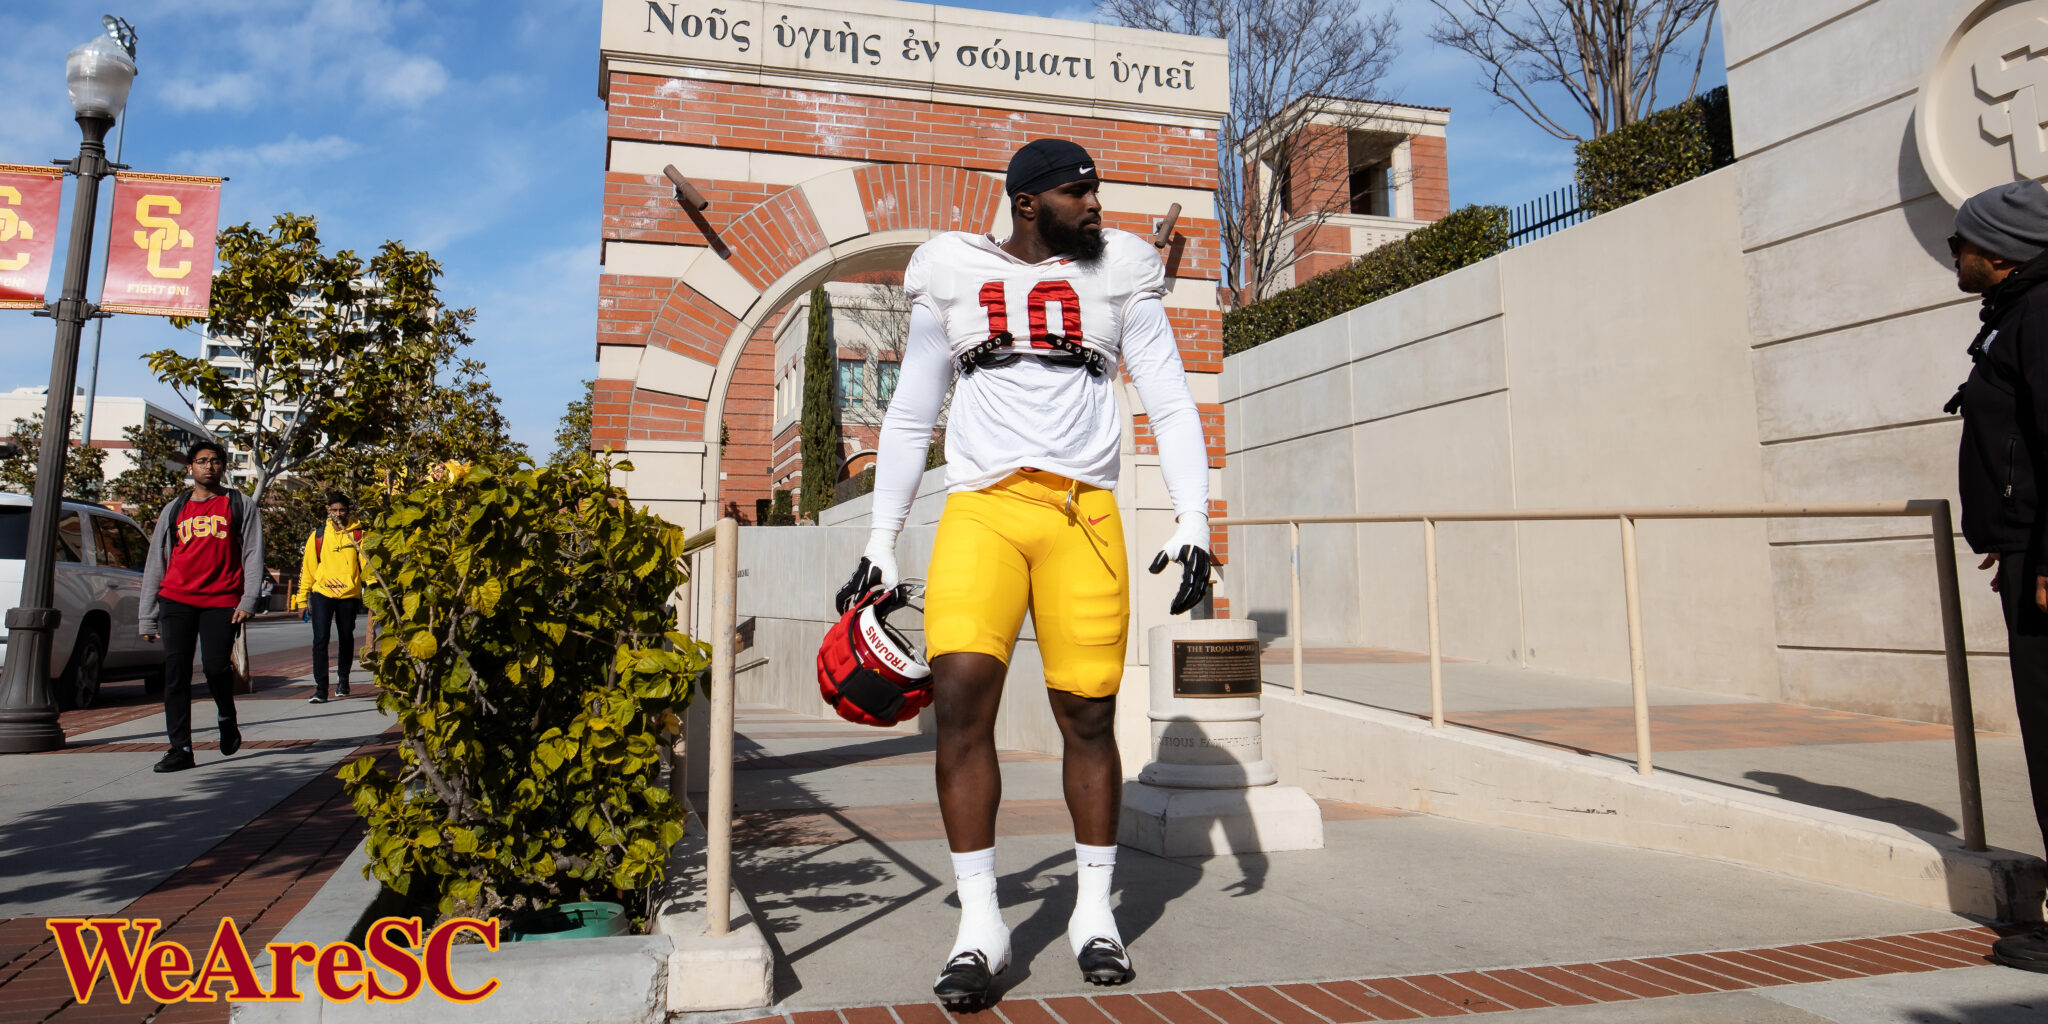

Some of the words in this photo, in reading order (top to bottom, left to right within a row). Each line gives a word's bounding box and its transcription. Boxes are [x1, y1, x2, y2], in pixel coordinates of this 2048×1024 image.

[643, 1, 751, 52] Νοῦς
[956, 39, 1096, 81] σώματι
[133, 194, 194, 279] SC
[127, 283, 166, 295] FIGHT
[168, 285, 190, 296] ON!
[979, 280, 1083, 349] 10
[177, 514, 227, 544] USC
[865, 625, 908, 672] TROJANS
[1187, 645, 1203, 653] THE
[1205, 645, 1234, 653] TROJAN
